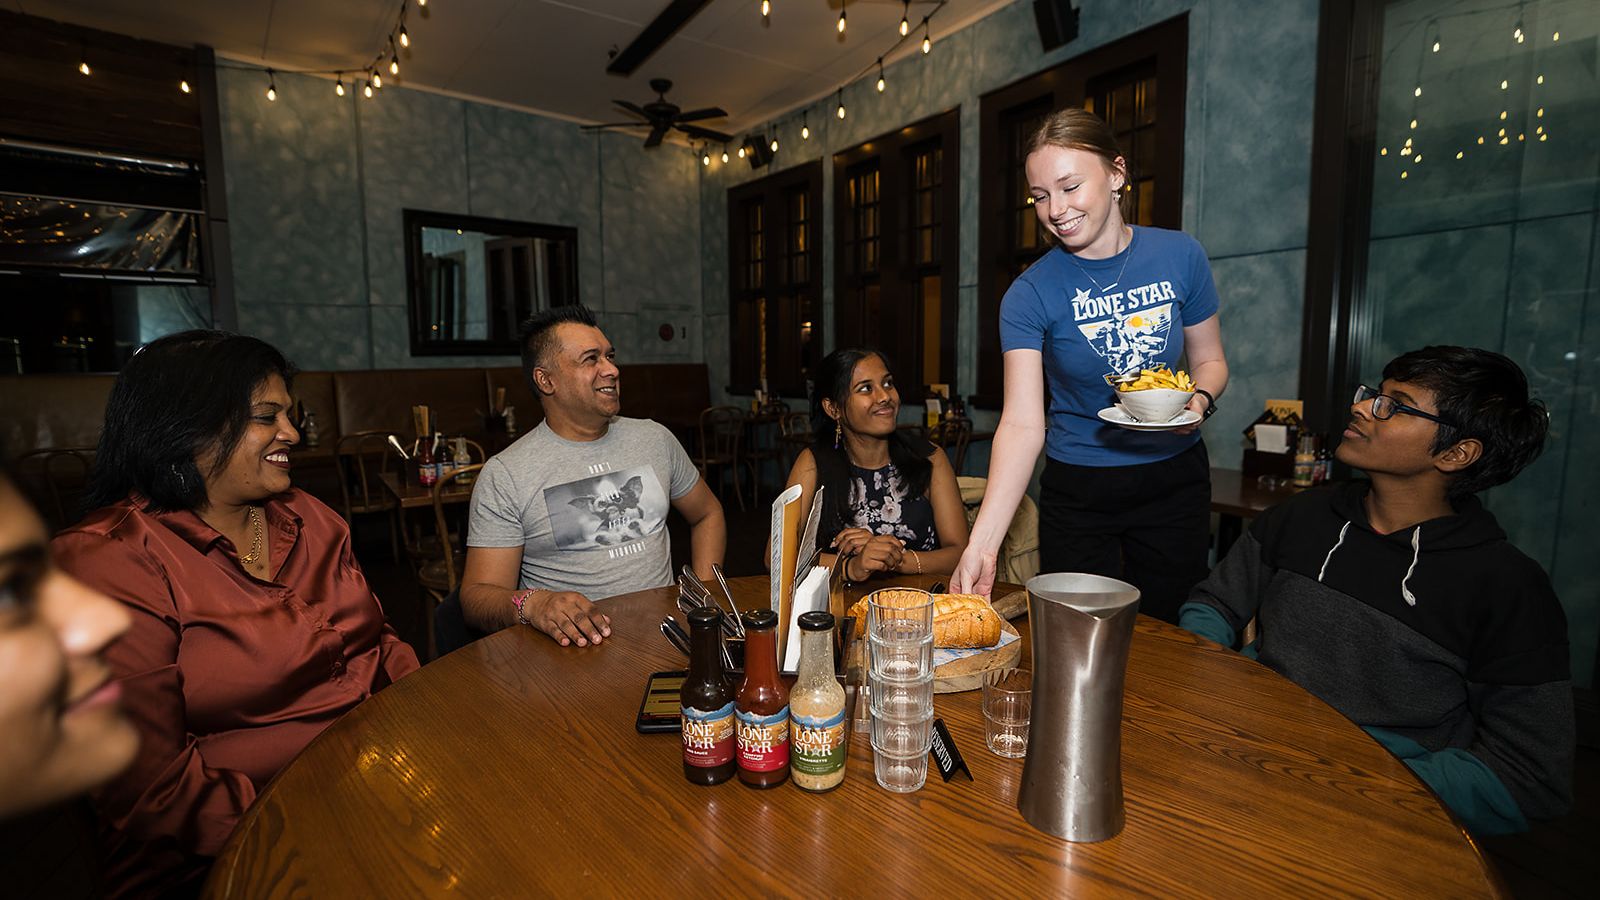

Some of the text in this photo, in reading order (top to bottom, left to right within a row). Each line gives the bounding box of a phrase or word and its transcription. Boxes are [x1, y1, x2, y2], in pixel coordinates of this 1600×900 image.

[1072, 280, 1176, 321] LONE STAR
[608, 541, 646, 559] MIDNIGHT
[682, 718, 715, 737] LONE
[737, 723, 773, 741] LONE
[795, 727, 832, 744] LONE
